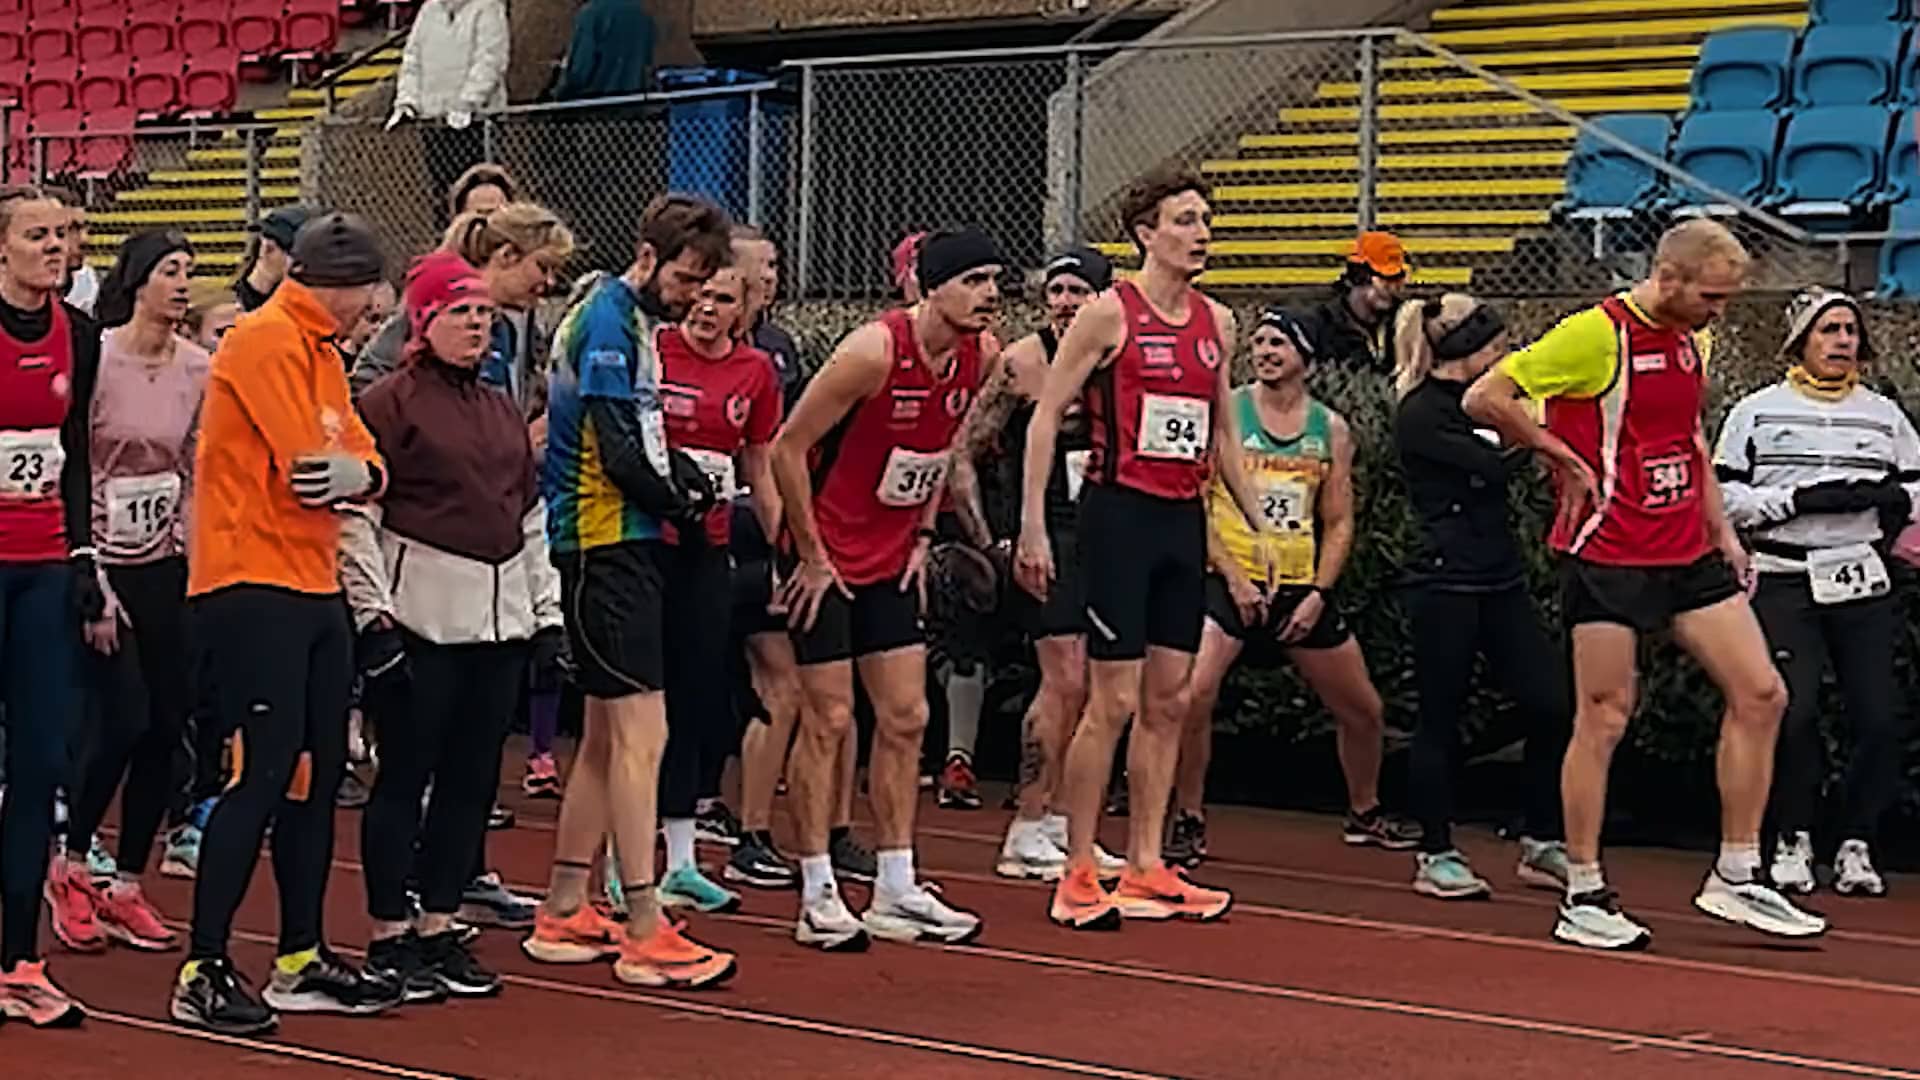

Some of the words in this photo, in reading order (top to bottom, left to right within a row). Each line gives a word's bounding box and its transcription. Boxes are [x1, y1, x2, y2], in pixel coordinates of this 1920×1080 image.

[9, 453, 44, 480] 23
[128, 496, 167, 523] 116
[1264, 496, 1289, 518] 25
[1835, 563, 1865, 585] 41
